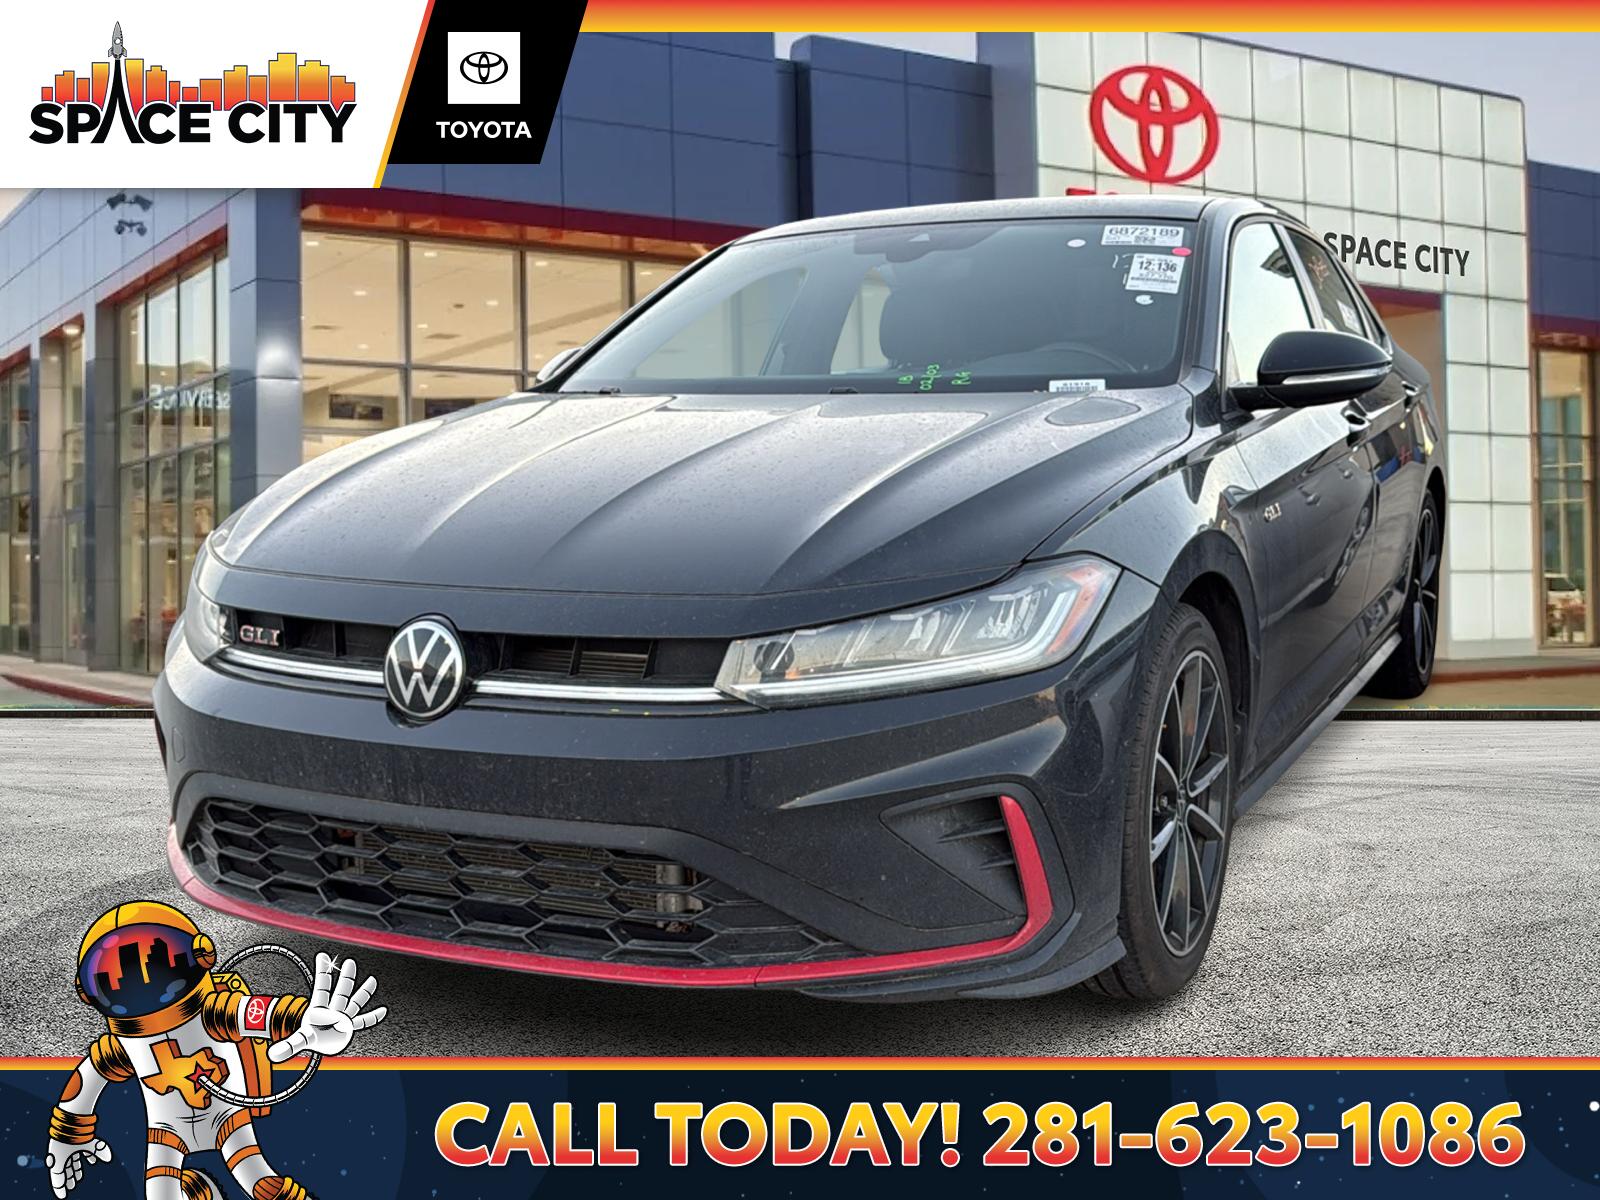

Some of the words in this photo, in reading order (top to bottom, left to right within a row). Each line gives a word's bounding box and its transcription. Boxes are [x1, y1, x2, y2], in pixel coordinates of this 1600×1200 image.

[1108, 227, 1180, 237] 6872189
[1324, 232, 1407, 269] SPACE
[1414, 244, 1470, 277] CITY
[239, 624, 280, 646] GLI
